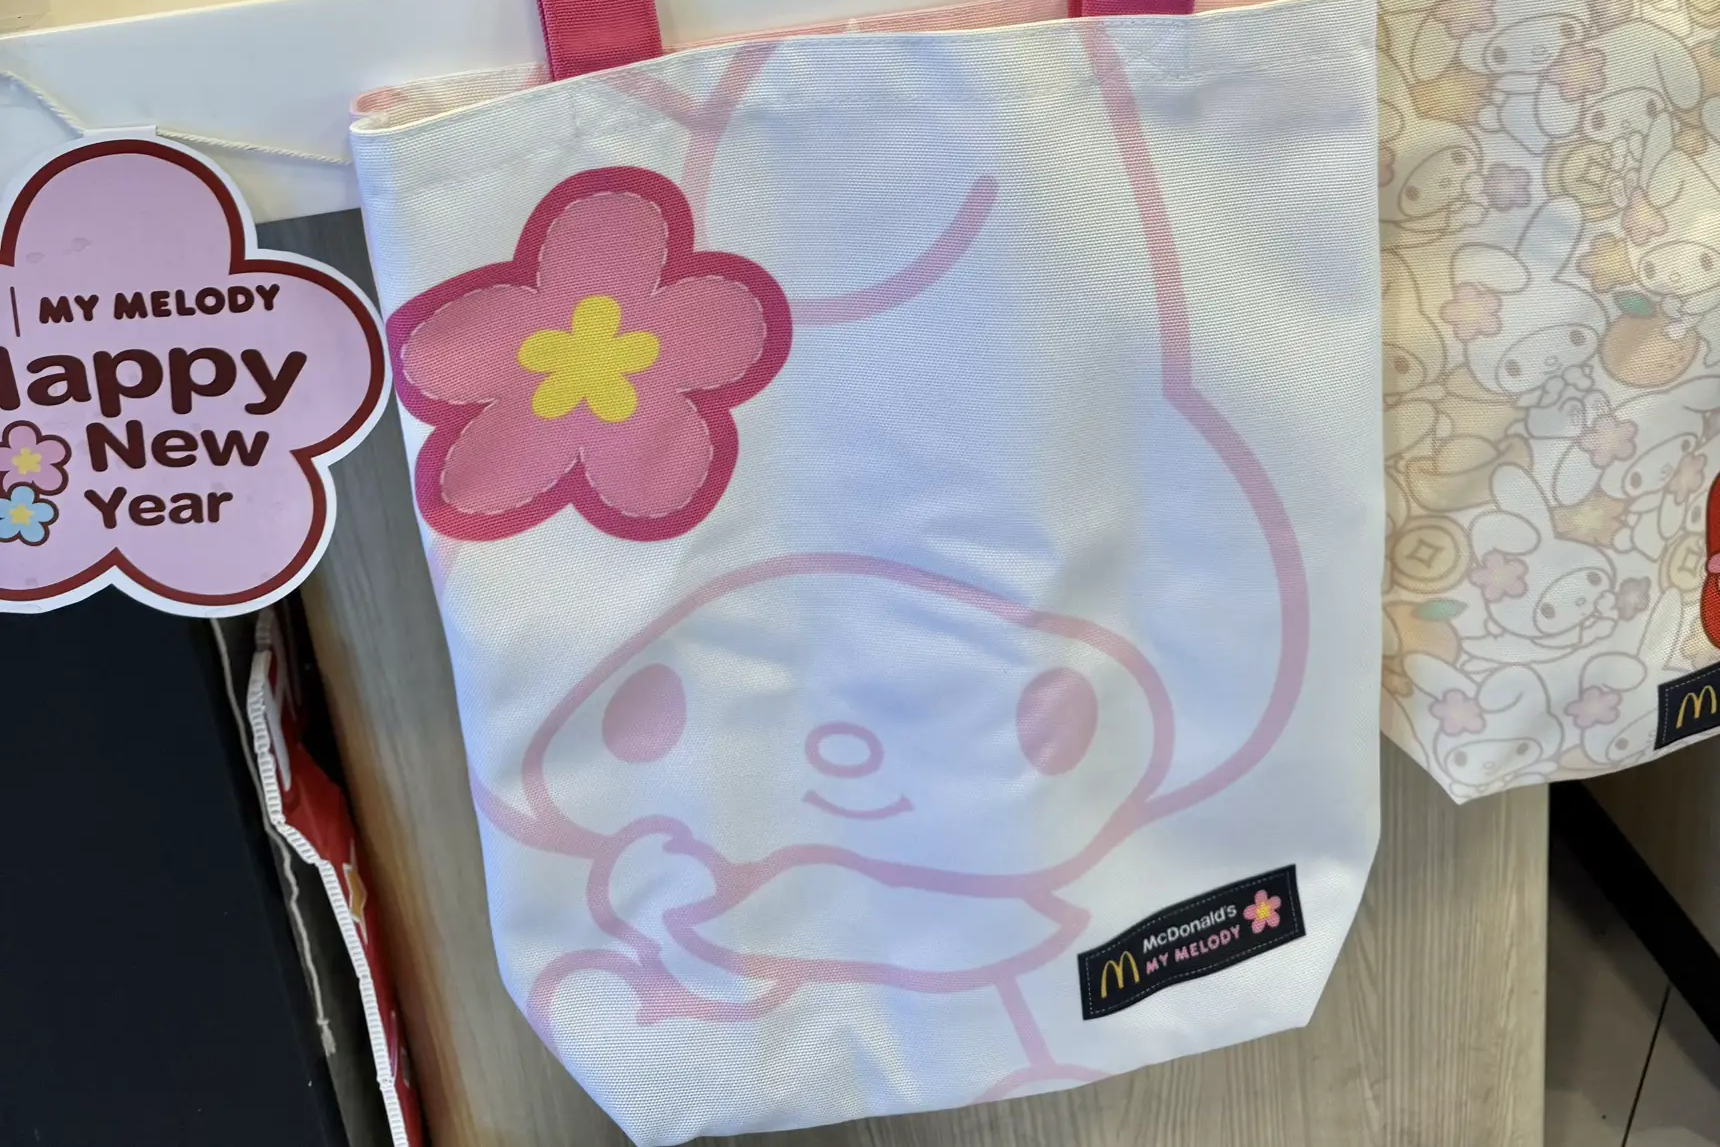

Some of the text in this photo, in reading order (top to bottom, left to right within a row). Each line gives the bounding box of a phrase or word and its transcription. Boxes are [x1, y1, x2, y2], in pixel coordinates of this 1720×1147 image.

[38, 283, 281, 324] MY MELODY
[85, 419, 270, 472] New
[83, 486, 234, 530] Year
[1142, 903, 1238, 954] McDonald's
[1145, 924, 1242, 975] MY MELODY
